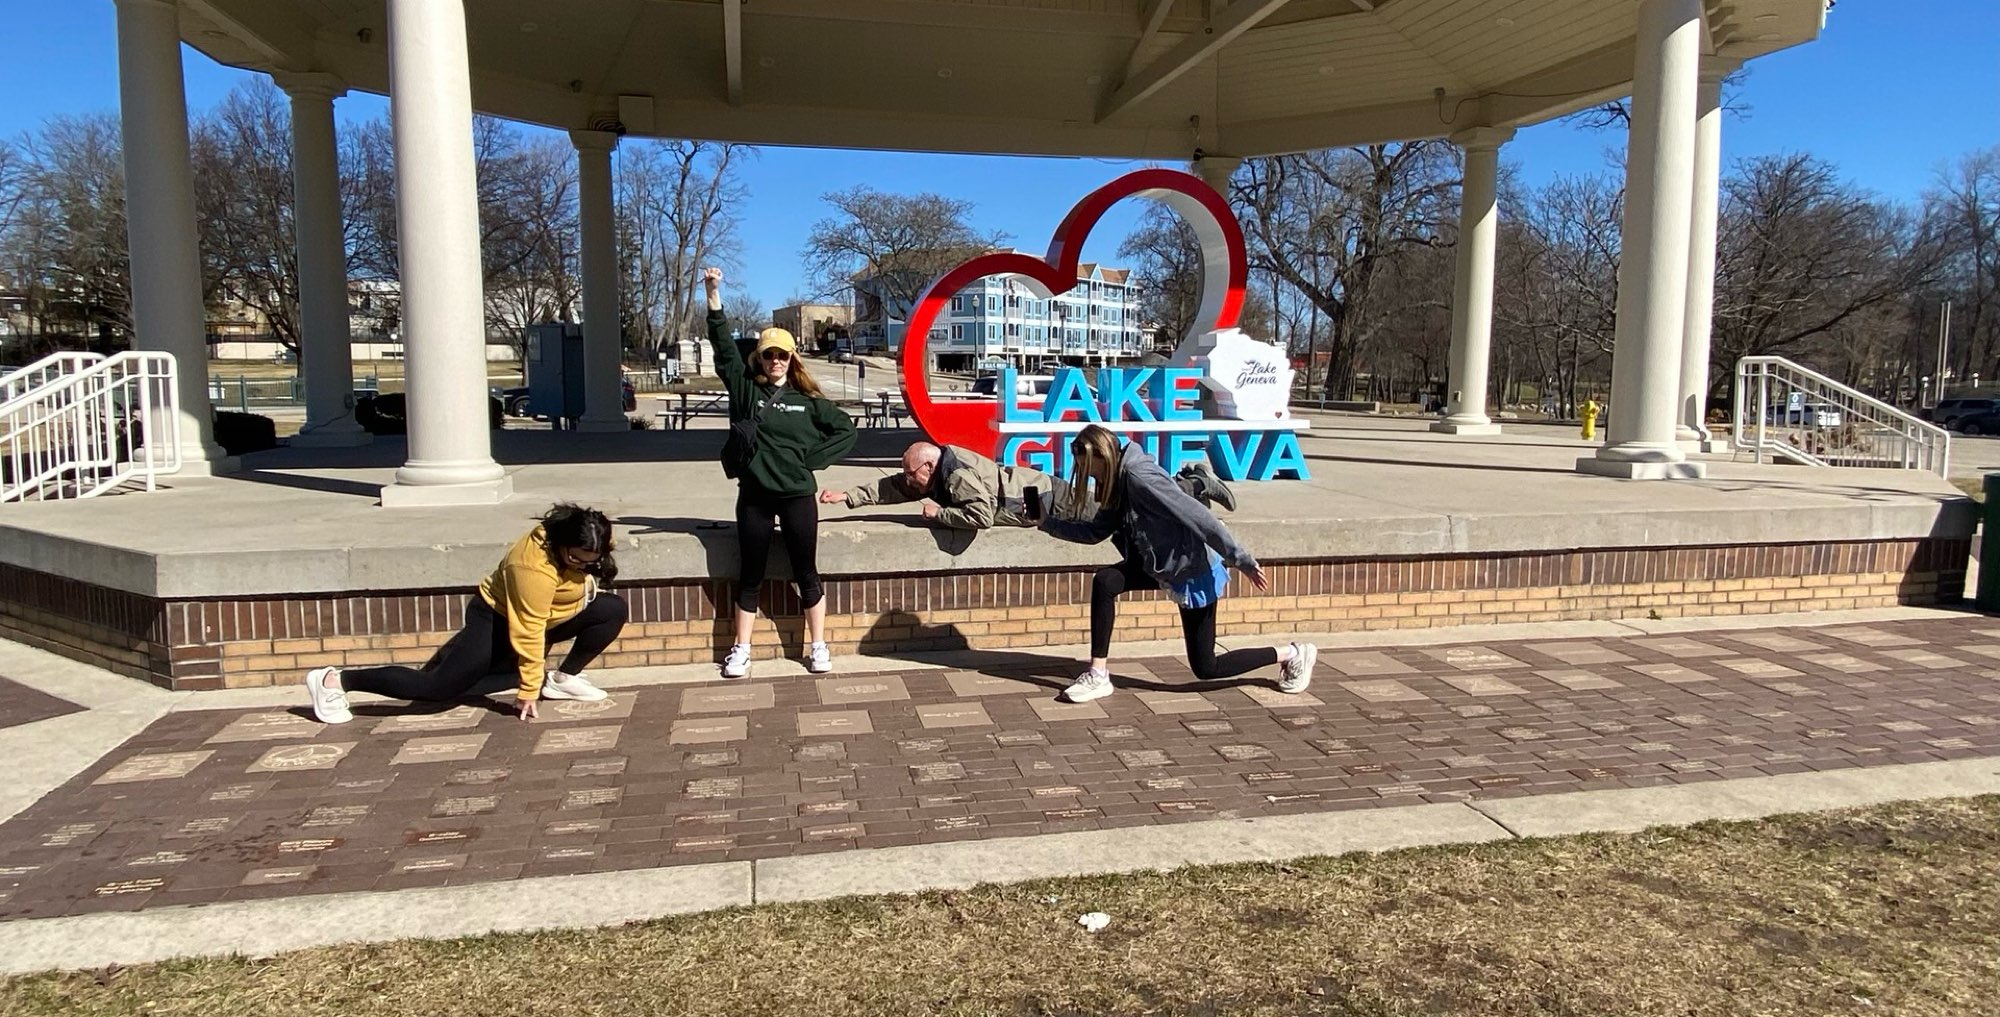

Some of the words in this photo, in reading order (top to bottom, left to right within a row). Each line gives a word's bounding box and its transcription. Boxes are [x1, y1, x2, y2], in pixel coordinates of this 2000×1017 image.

[1249, 361, 1277, 375] Lake
[1235, 371, 1278, 389] Geneva
[1004, 367, 1204, 422] LAKE
